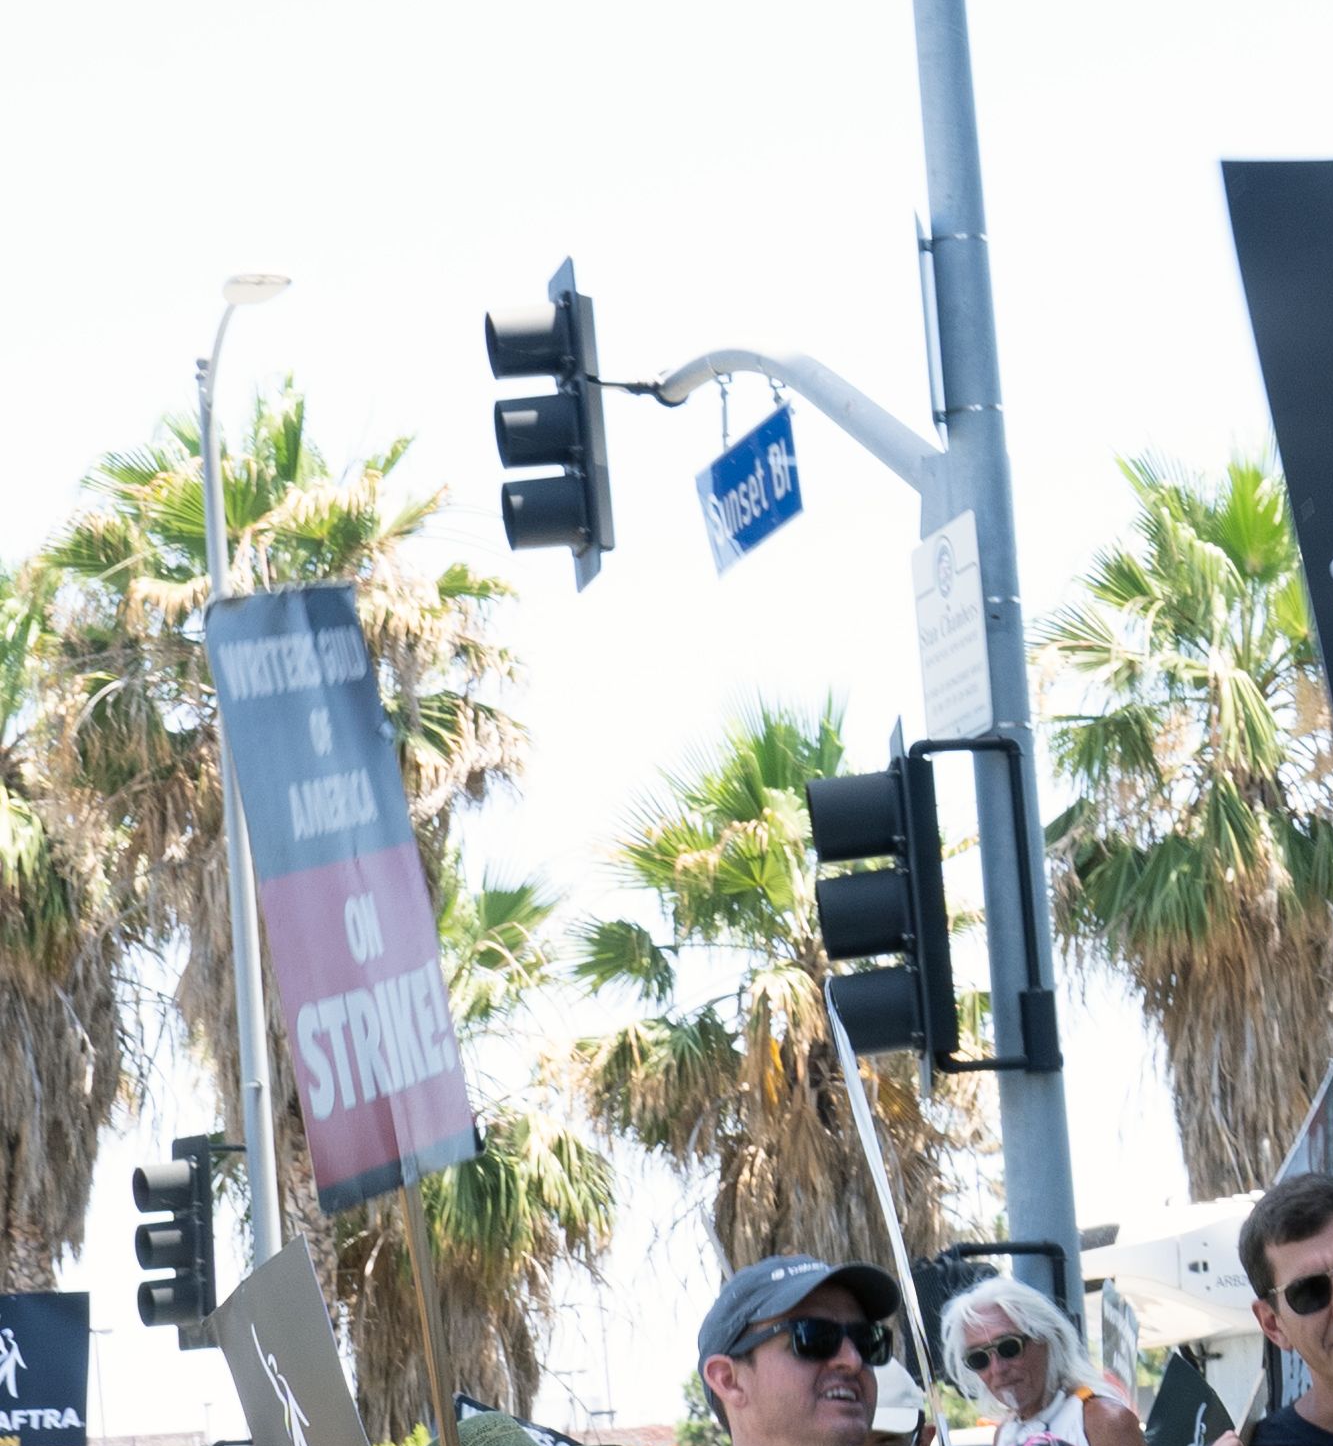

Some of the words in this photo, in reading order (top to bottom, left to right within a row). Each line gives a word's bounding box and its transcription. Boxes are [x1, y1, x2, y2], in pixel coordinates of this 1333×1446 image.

[707, 458, 770, 547] Sunset
[768, 437, 792, 501] Bl
[343, 890, 384, 966] ON
[296, 960, 458, 1122] STRIKE!
